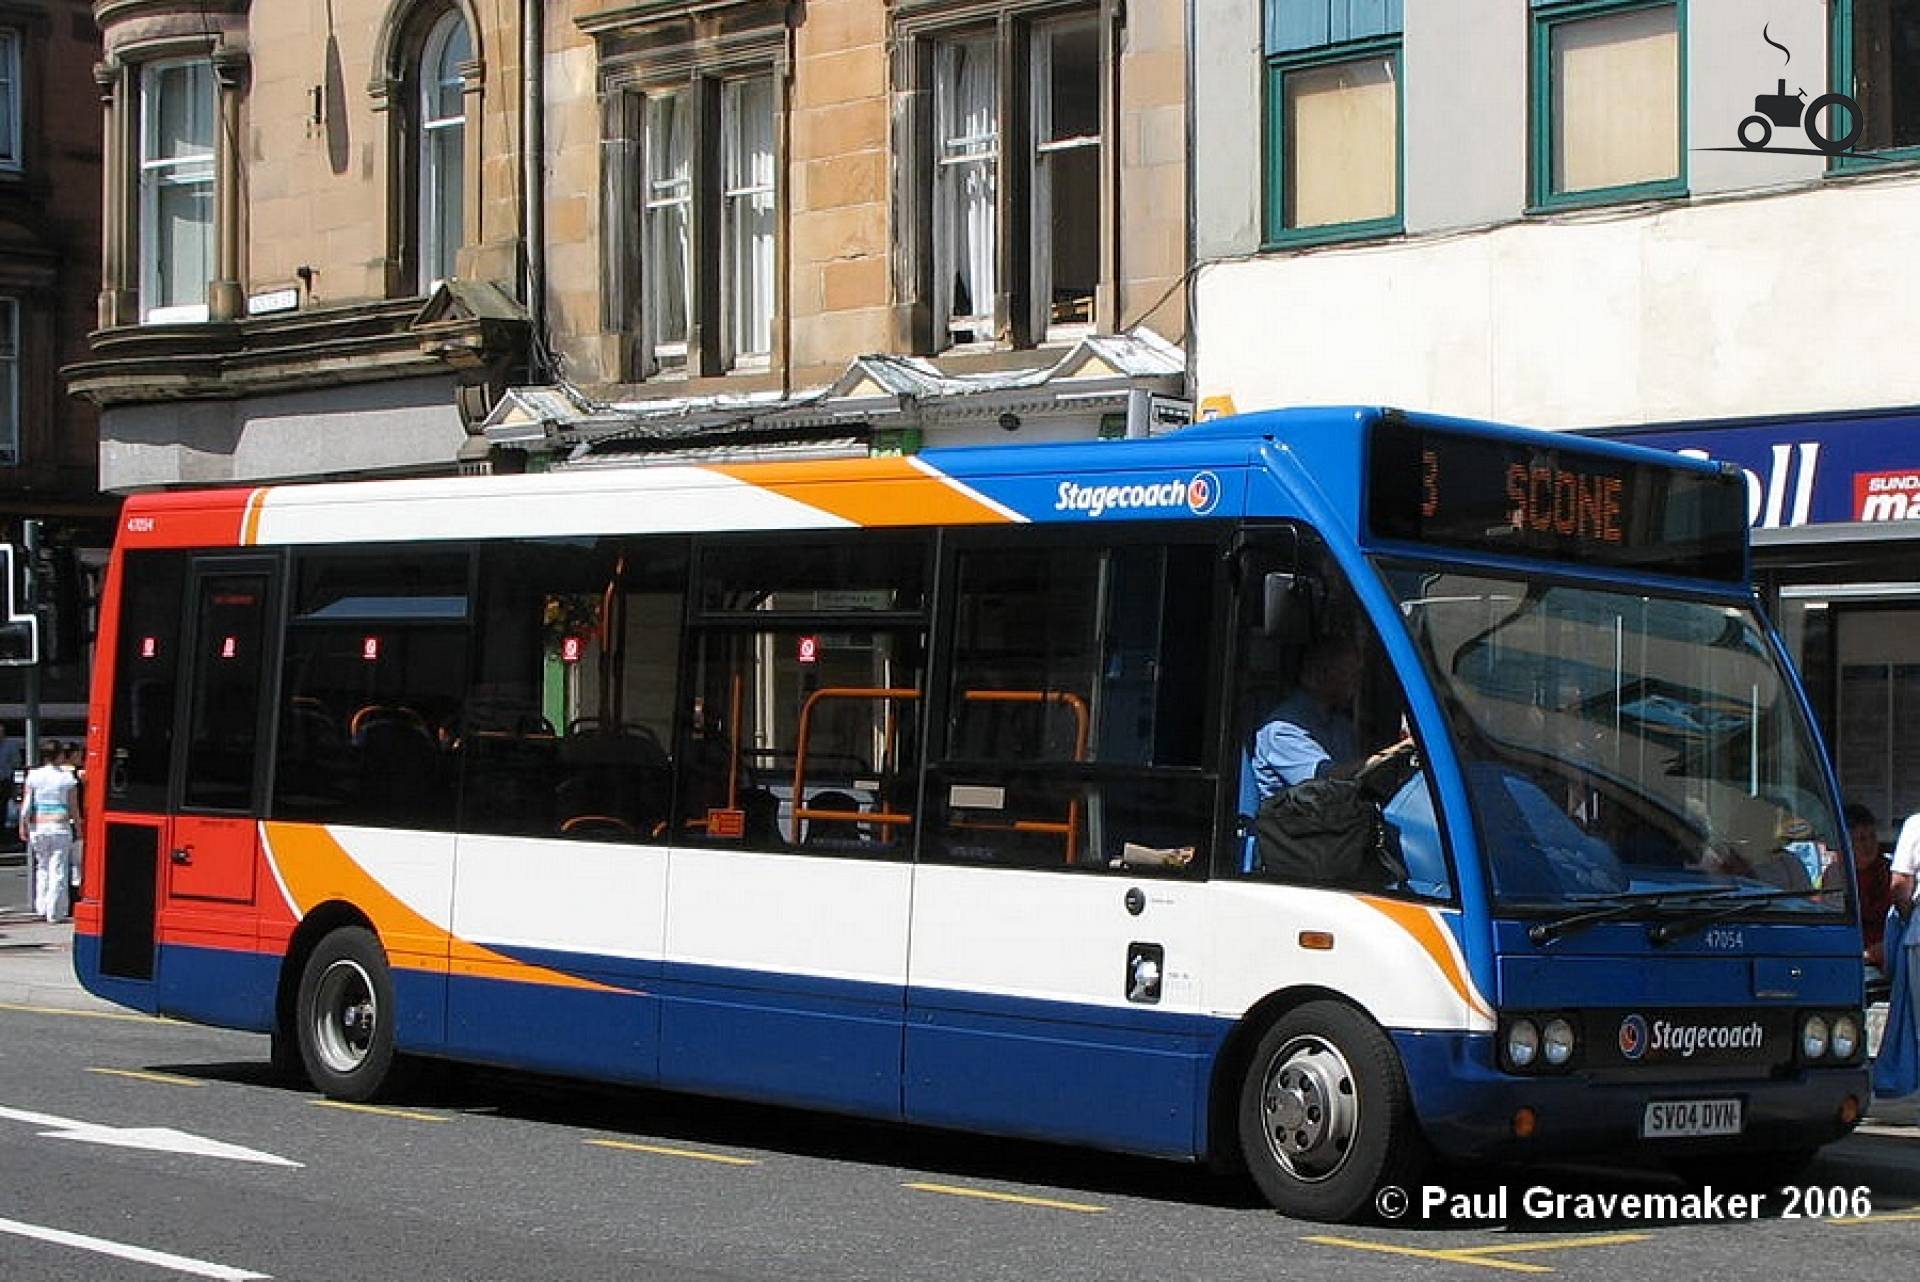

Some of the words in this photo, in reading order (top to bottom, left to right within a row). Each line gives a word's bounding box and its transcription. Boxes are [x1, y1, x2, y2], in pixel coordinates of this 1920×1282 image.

[1055, 479, 1186, 517] Stagecoach
[1868, 475, 1920, 491] SUND
[1506, 463, 1622, 541] SCONE
[1705, 930, 1744, 948] 47054
[1651, 1020, 1763, 1057] Stagecoach
[1652, 1104, 1697, 1129] SV04
[1702, 1102, 1735, 1128] DVN
